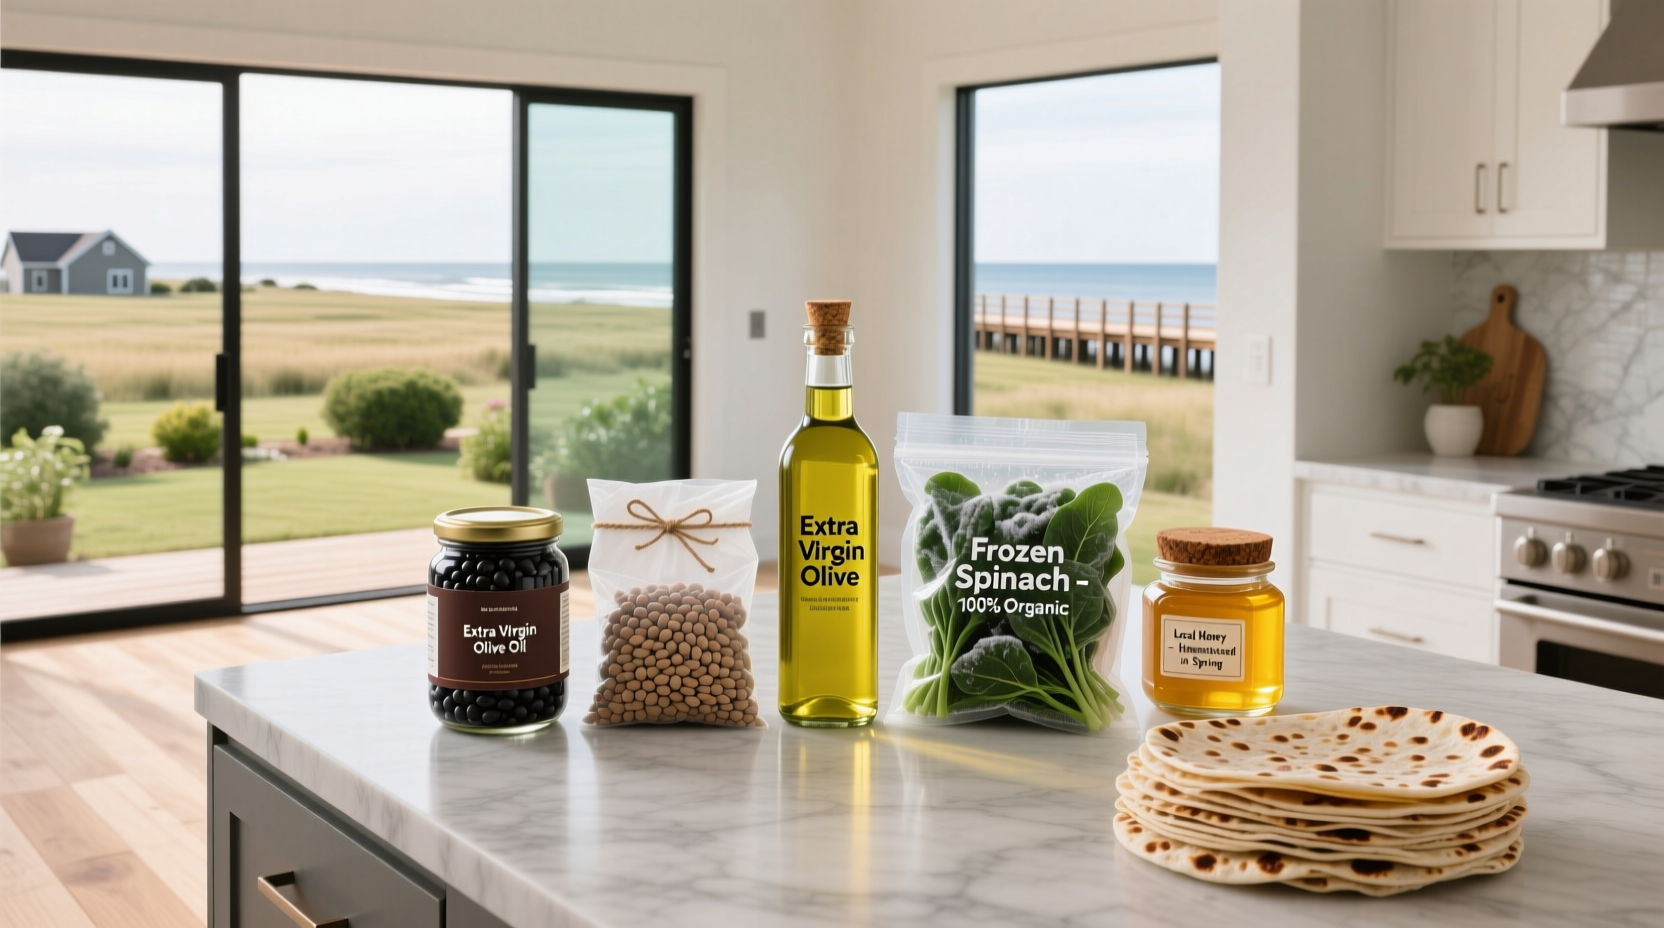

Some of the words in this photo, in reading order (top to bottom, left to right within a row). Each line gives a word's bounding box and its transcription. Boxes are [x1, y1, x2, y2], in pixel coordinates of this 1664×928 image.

[800, 515, 859, 536] Extra
[798, 540, 865, 566] Virgin
[971, 536, 1065, 564] Frozen
[800, 565, 860, 586] Olive
[954, 563, 1070, 595] Spinach
[957, 597, 1002, 614] 100%
[1003, 598, 1070, 618] Organic
[463, 624, 497, 638] Extra
[473, 641, 506, 655] Olive
